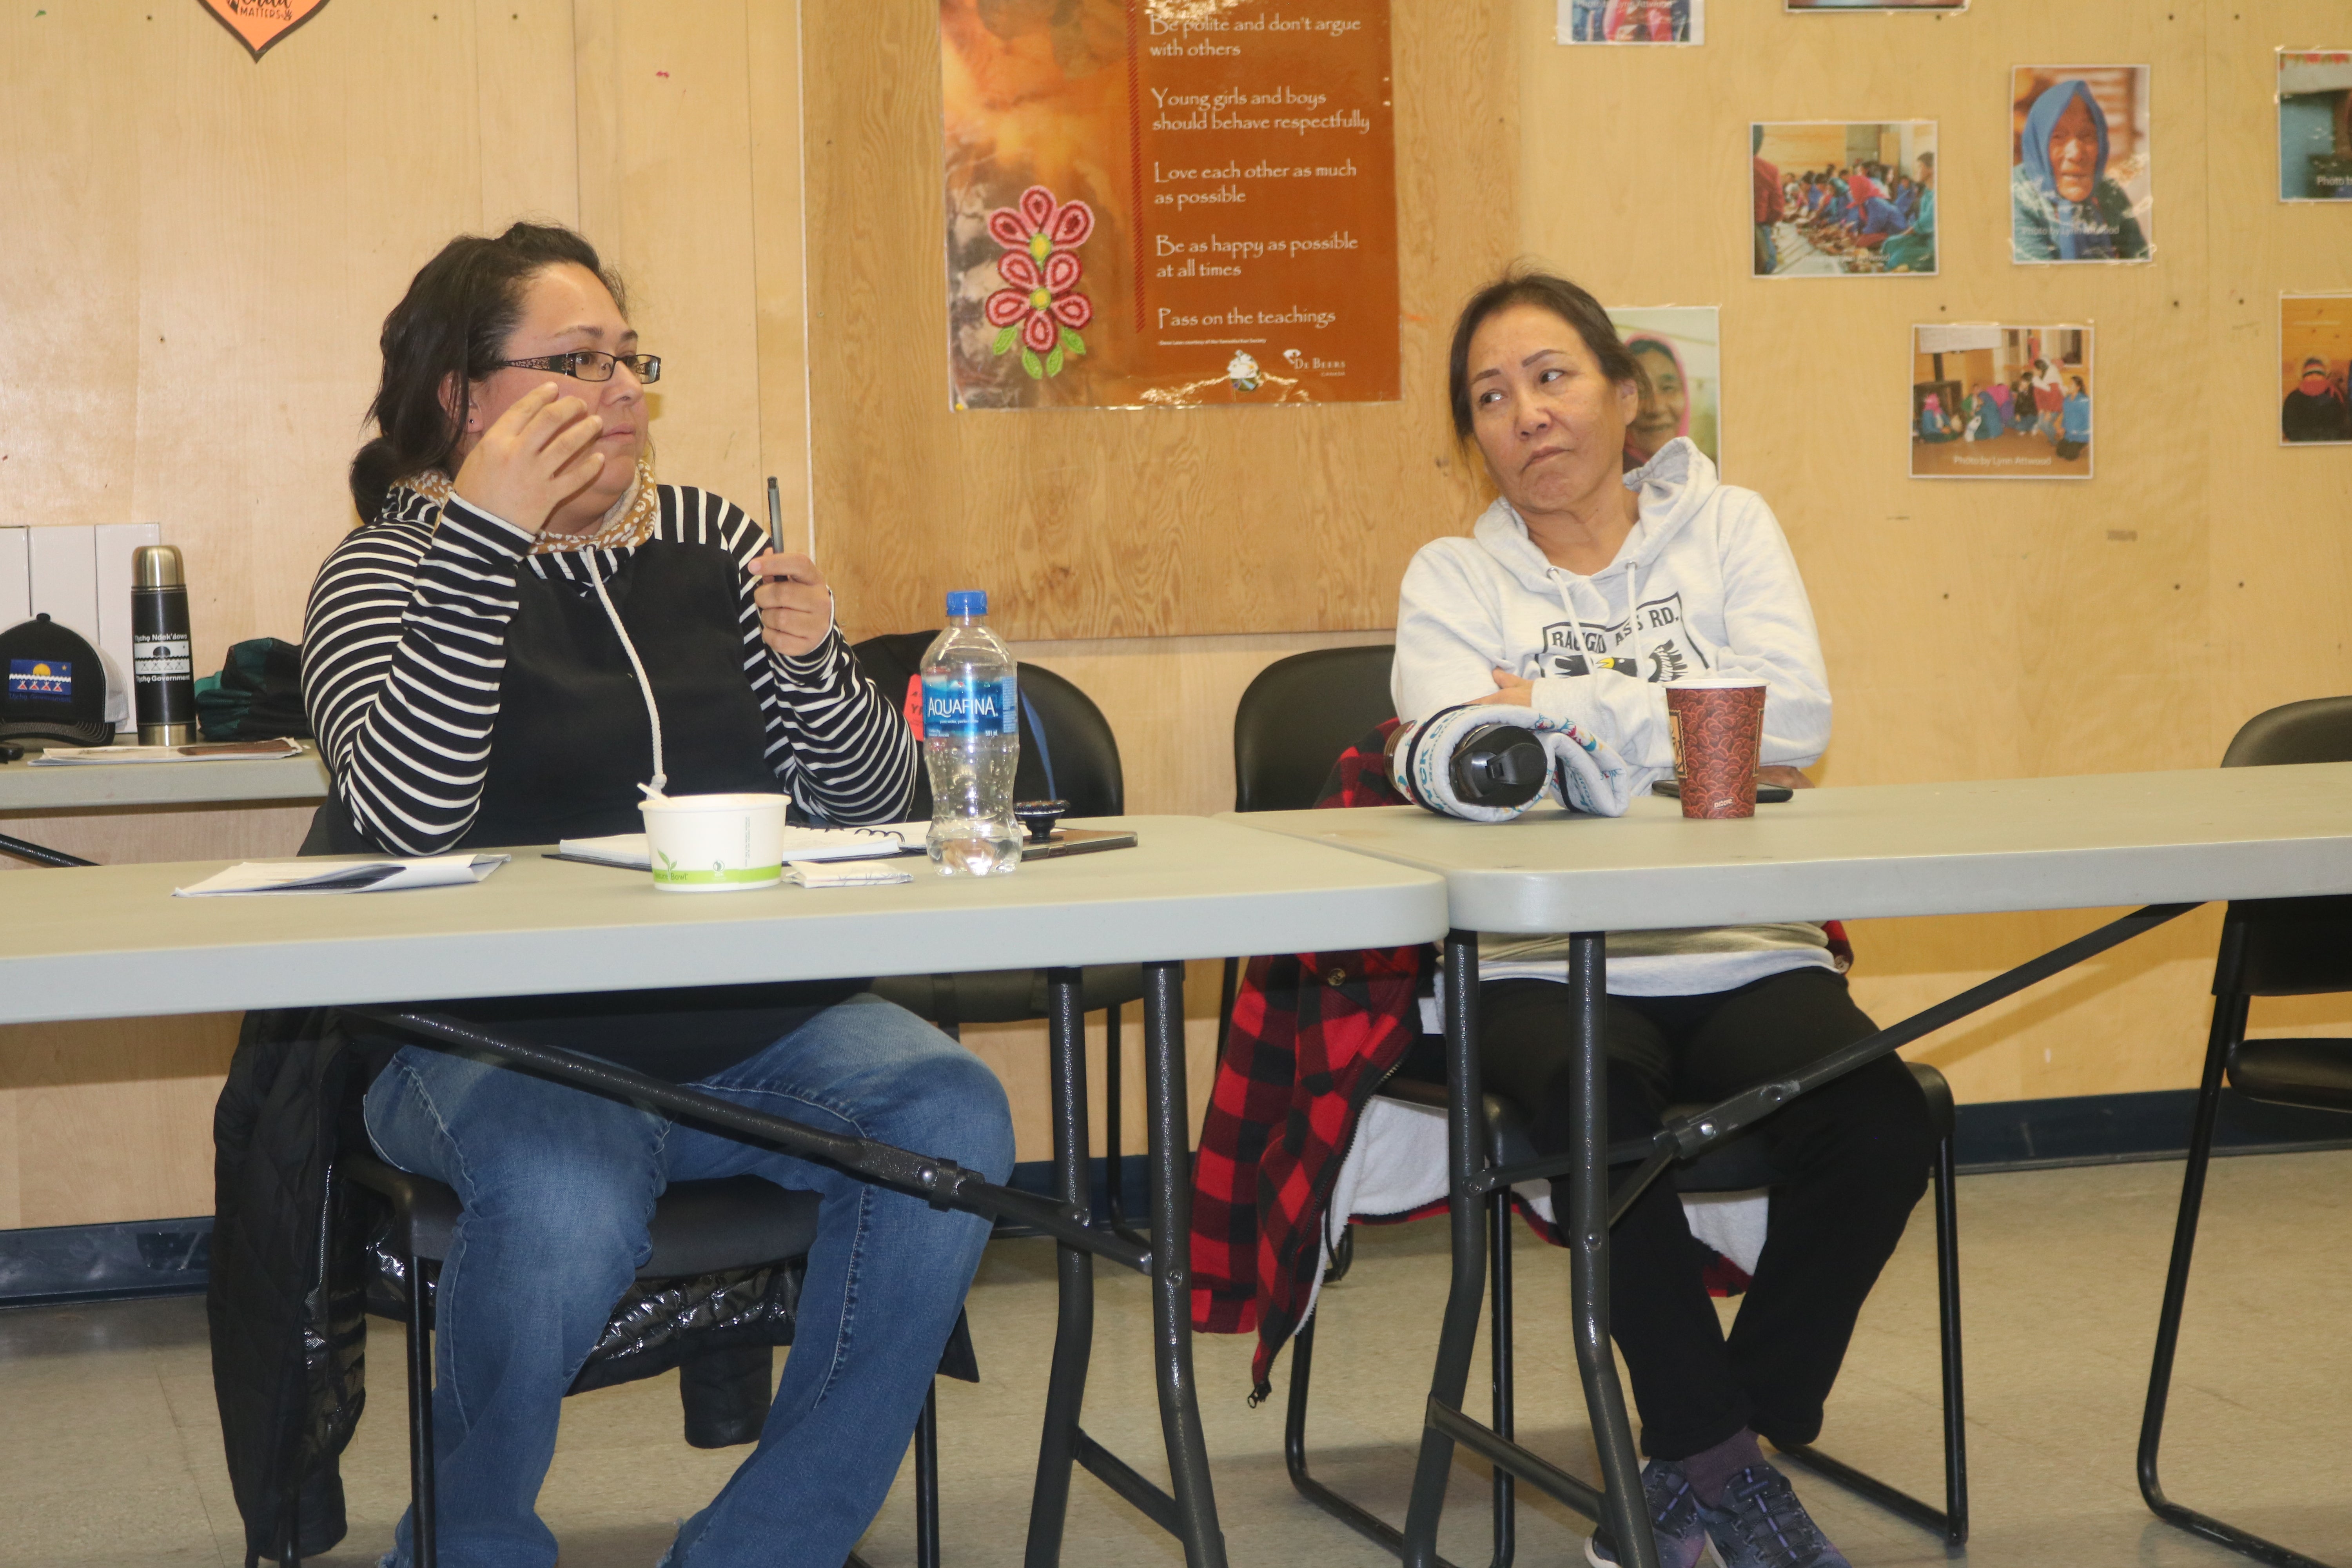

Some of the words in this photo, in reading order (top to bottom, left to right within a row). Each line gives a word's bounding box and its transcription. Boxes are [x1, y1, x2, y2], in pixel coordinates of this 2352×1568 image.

[240, 6, 281, 19] MATTERS
[1149, 13, 1178, 35] Be
[1183, 13, 1230, 40] polite
[1233, 13, 1264, 31] and
[1268, 12, 1311, 31] don't
[1314, 18, 1361, 36] argue
[1149, 38, 1183, 56] with
[1187, 38, 1241, 56] others
[1150, 87, 1210, 111] Young
[1213, 85, 1247, 111] girls
[1250, 86, 1281, 105] and
[1285, 86, 1327, 111] boys
[1152, 111, 1207, 131] should
[1212, 111, 1270, 129] behave
[1274, 109, 1370, 136] respectfully
[1154, 161, 1197, 183] Love
[1201, 160, 1240, 178] each
[1244, 159, 1290, 179] other
[1293, 166, 1312, 177] as
[1315, 158, 1356, 177] much
[2317, 175, 2345, 186] Photo
[2346, 174, 2352, 186] b
[1154, 192, 1174, 204] as
[1178, 184, 1246, 212] possible
[1156, 235, 1185, 256] Be
[1189, 241, 1208, 252] as
[1211, 234, 1264, 259] happy
[1267, 240, 1287, 251] as
[1290, 231, 1359, 258] possible
[1156, 264, 1174, 278] at
[1177, 259, 1195, 277] all
[1199, 262, 1241, 277] times
[1158, 308, 1198, 330] Pass
[1201, 315, 1223, 326] on
[1227, 307, 1254, 325] the
[1258, 305, 1336, 328] teachings
[1953, 455, 1979, 465] Photo
[1980, 456, 1992, 467] by
[1993, 456, 2013, 466] Lynn
[2015, 456, 2052, 466] Attwood
[1648, 606, 1679, 628] RD.
